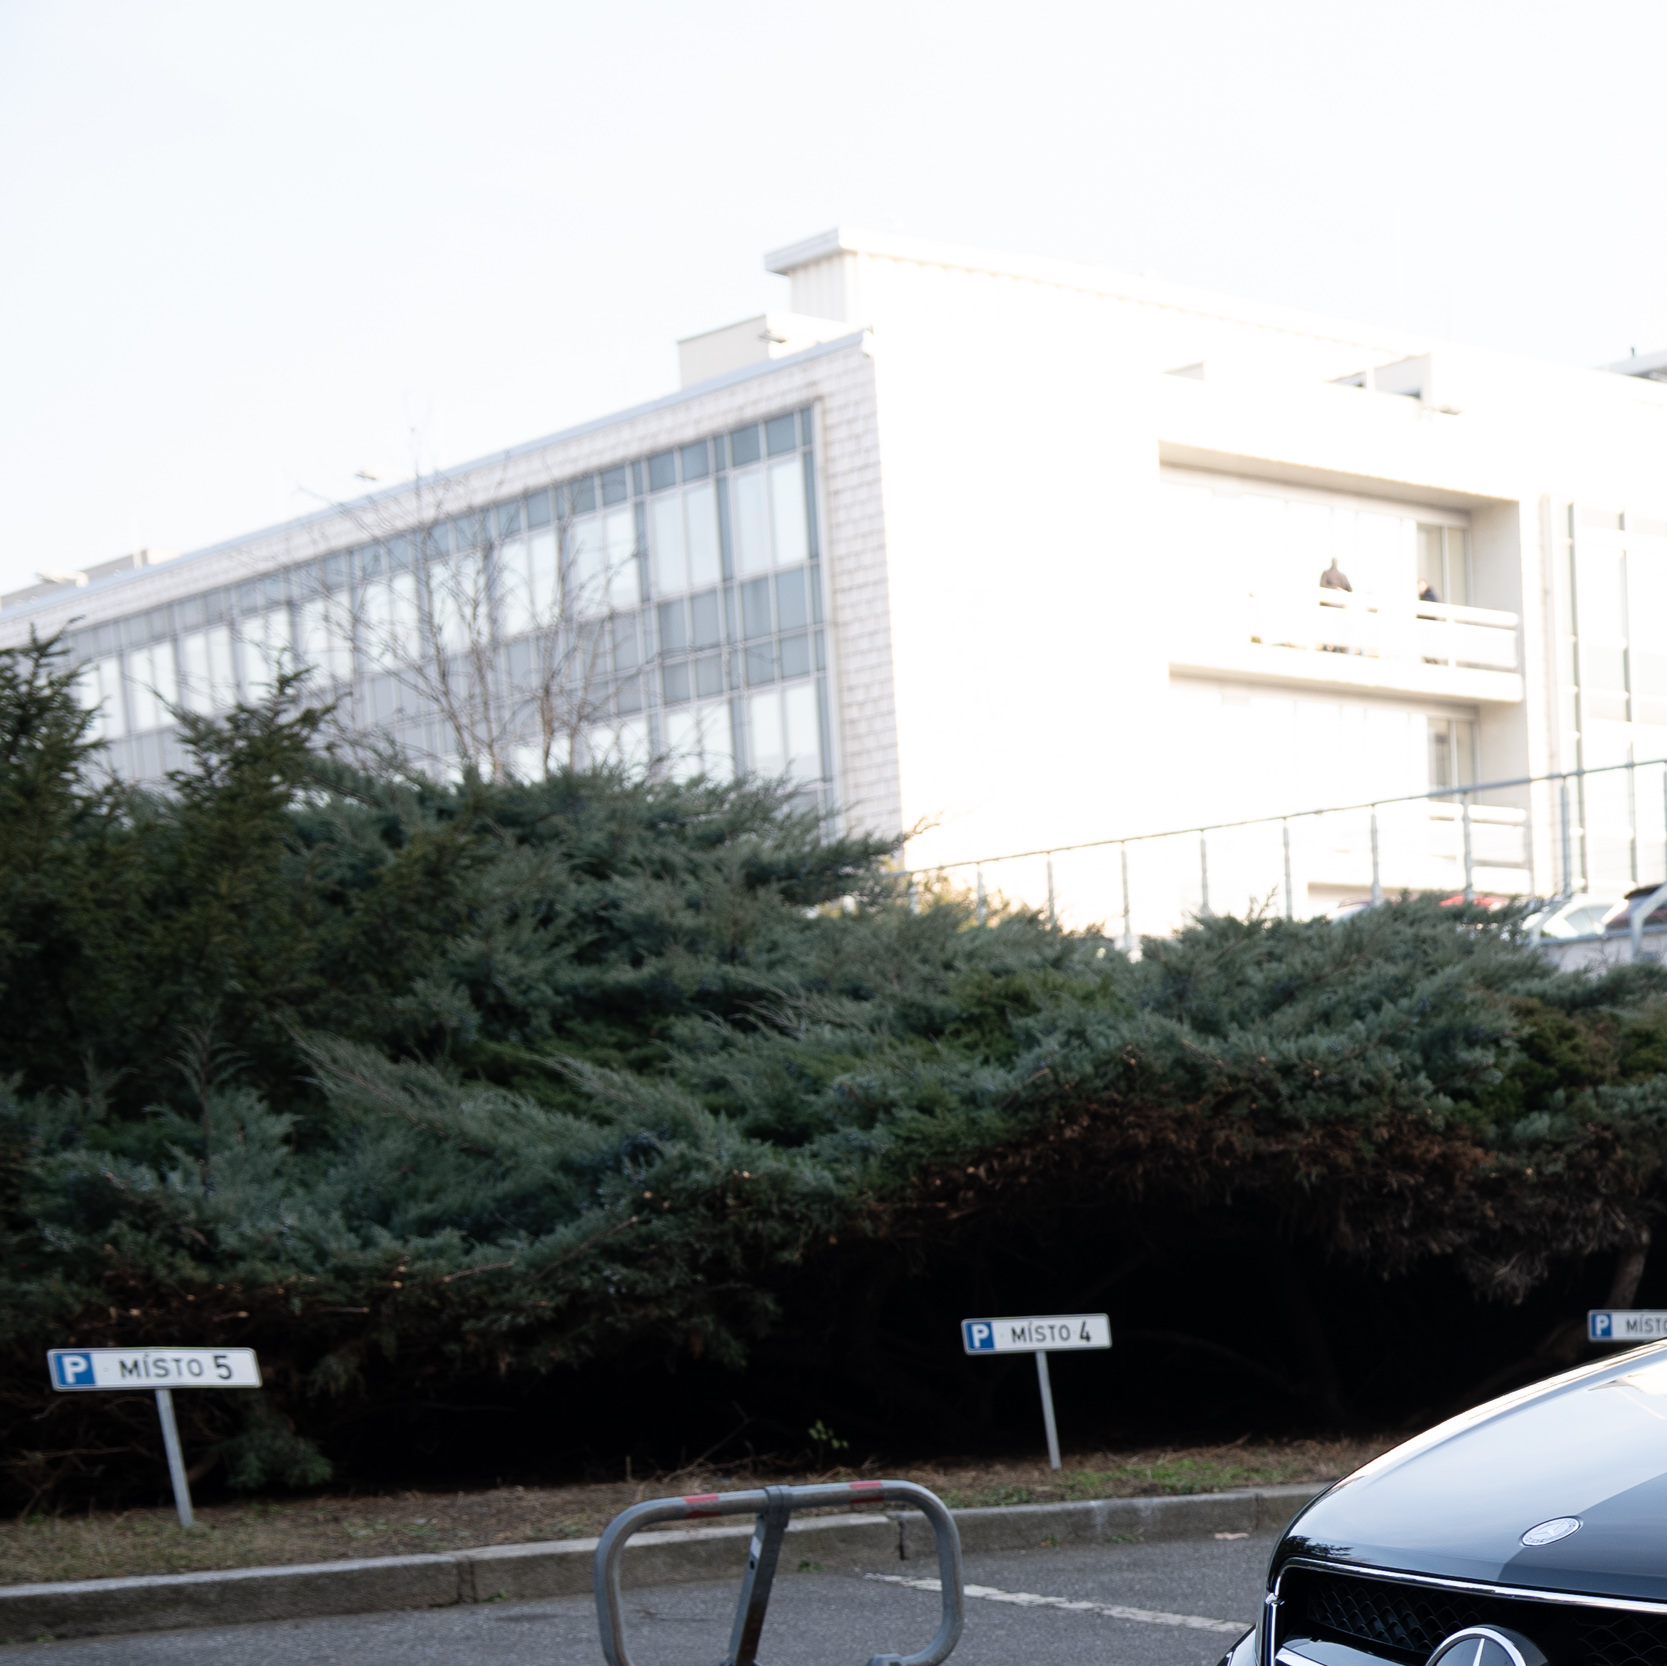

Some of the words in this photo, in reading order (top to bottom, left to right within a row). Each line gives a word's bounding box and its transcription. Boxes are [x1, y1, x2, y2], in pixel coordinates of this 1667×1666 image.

[970, 1323, 990, 1349] P
[1011, 1320, 1071, 1343] MÍSTO
[1079, 1319, 1092, 1342] 4
[1595, 1314, 1609, 1337] P
[62, 1355, 88, 1384] P
[119, 1353, 203, 1378] MÍSTO
[212, 1355, 232, 1380] 5
